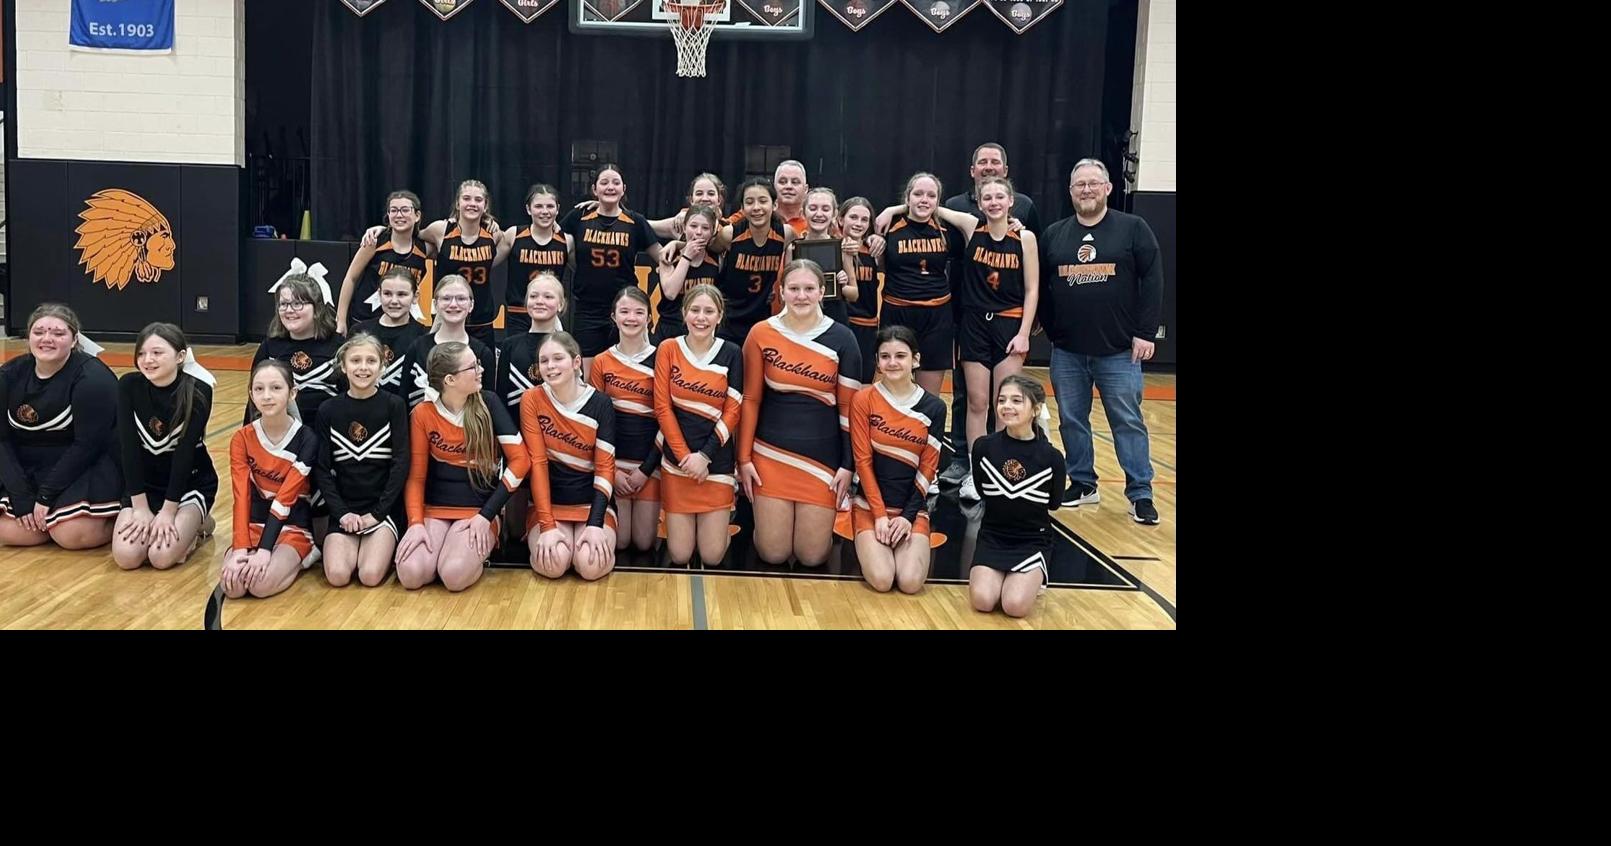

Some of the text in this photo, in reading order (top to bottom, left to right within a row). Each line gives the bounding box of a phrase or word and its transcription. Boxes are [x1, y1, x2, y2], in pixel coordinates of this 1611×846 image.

[763, 5, 783, 16] Boys
[846, 6, 866, 18] Boys
[930, 8, 950, 19] Boys
[1010, 10, 1031, 21] Boys
[89, 22, 155, 38] Est.1903
[583, 228, 630, 247] BLACKHAWKS
[519, 248, 565, 265] BLACKHAWKS
[590, 248, 621, 268] 53
[735, 253, 780, 272] BLACKHAWKS
[973, 246, 1020, 269] BLACKHAWKS
[918, 259, 930, 275] 1
[747, 275, 762, 293] 3
[986, 271, 1000, 291] 4
[1067, 272, 1109, 287] Nation
